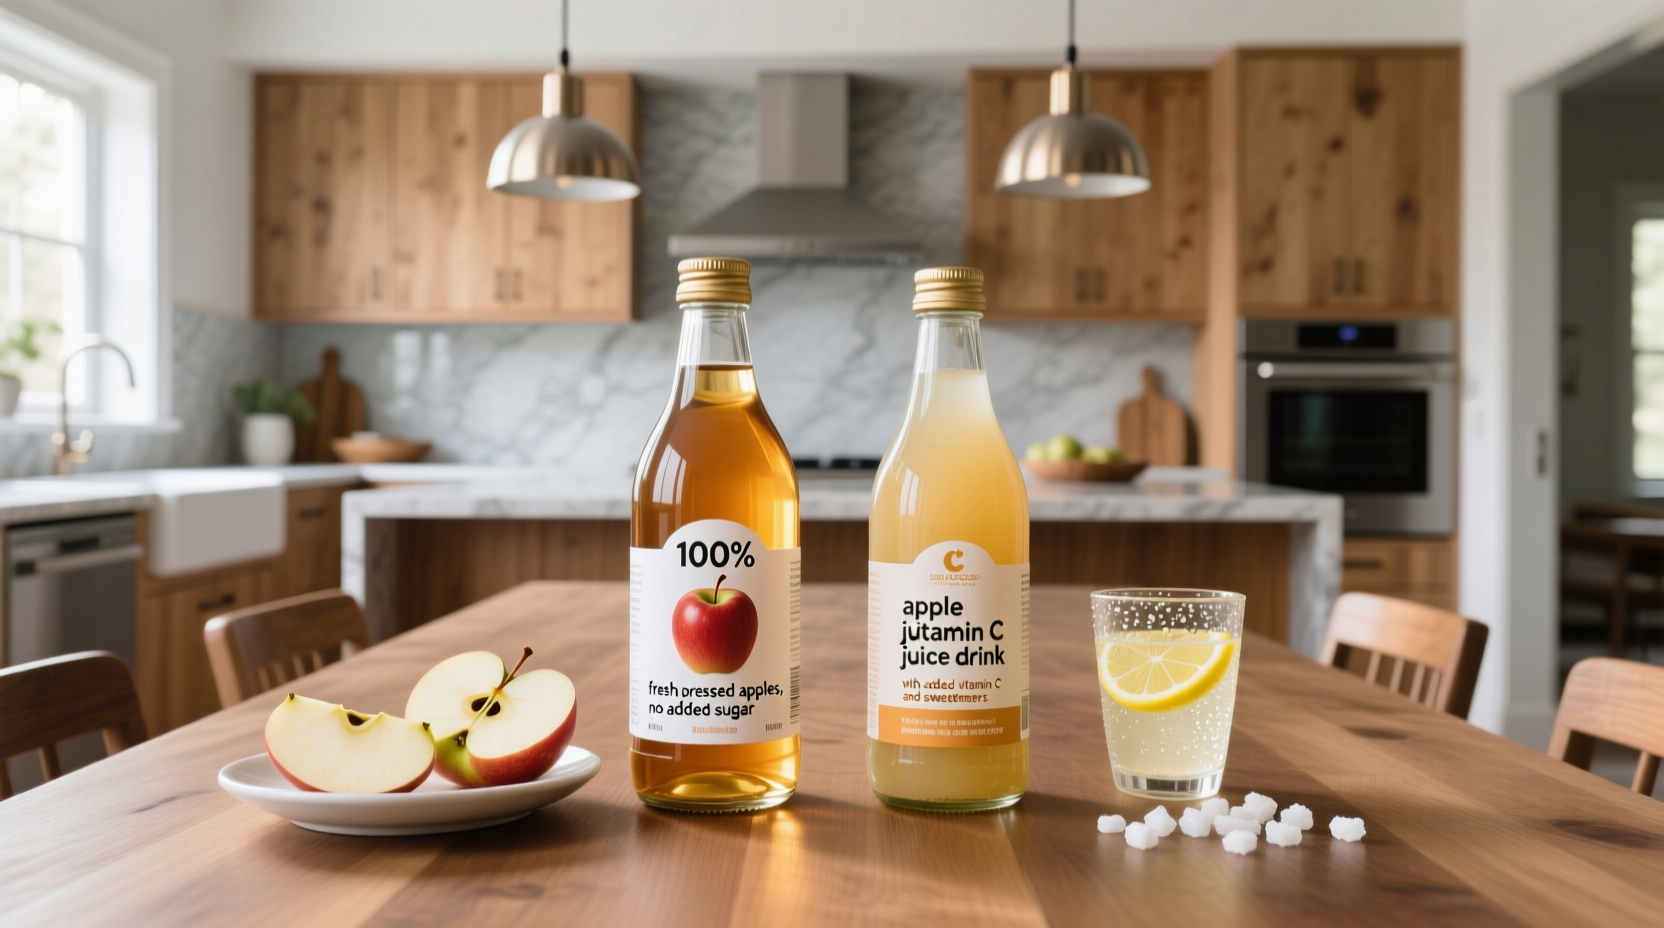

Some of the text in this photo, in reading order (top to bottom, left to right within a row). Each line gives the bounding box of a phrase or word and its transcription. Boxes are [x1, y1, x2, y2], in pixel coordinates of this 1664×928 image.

[676, 540, 755, 568] 100%
[903, 596, 963, 621] apple
[989, 620, 1004, 641] C
[900, 645, 1005, 670] juice drink
[739, 681, 784, 701] apples,
[994, 678, 1002, 689] C
[903, 692, 921, 702] and
[648, 701, 756, 720] no added sugar
